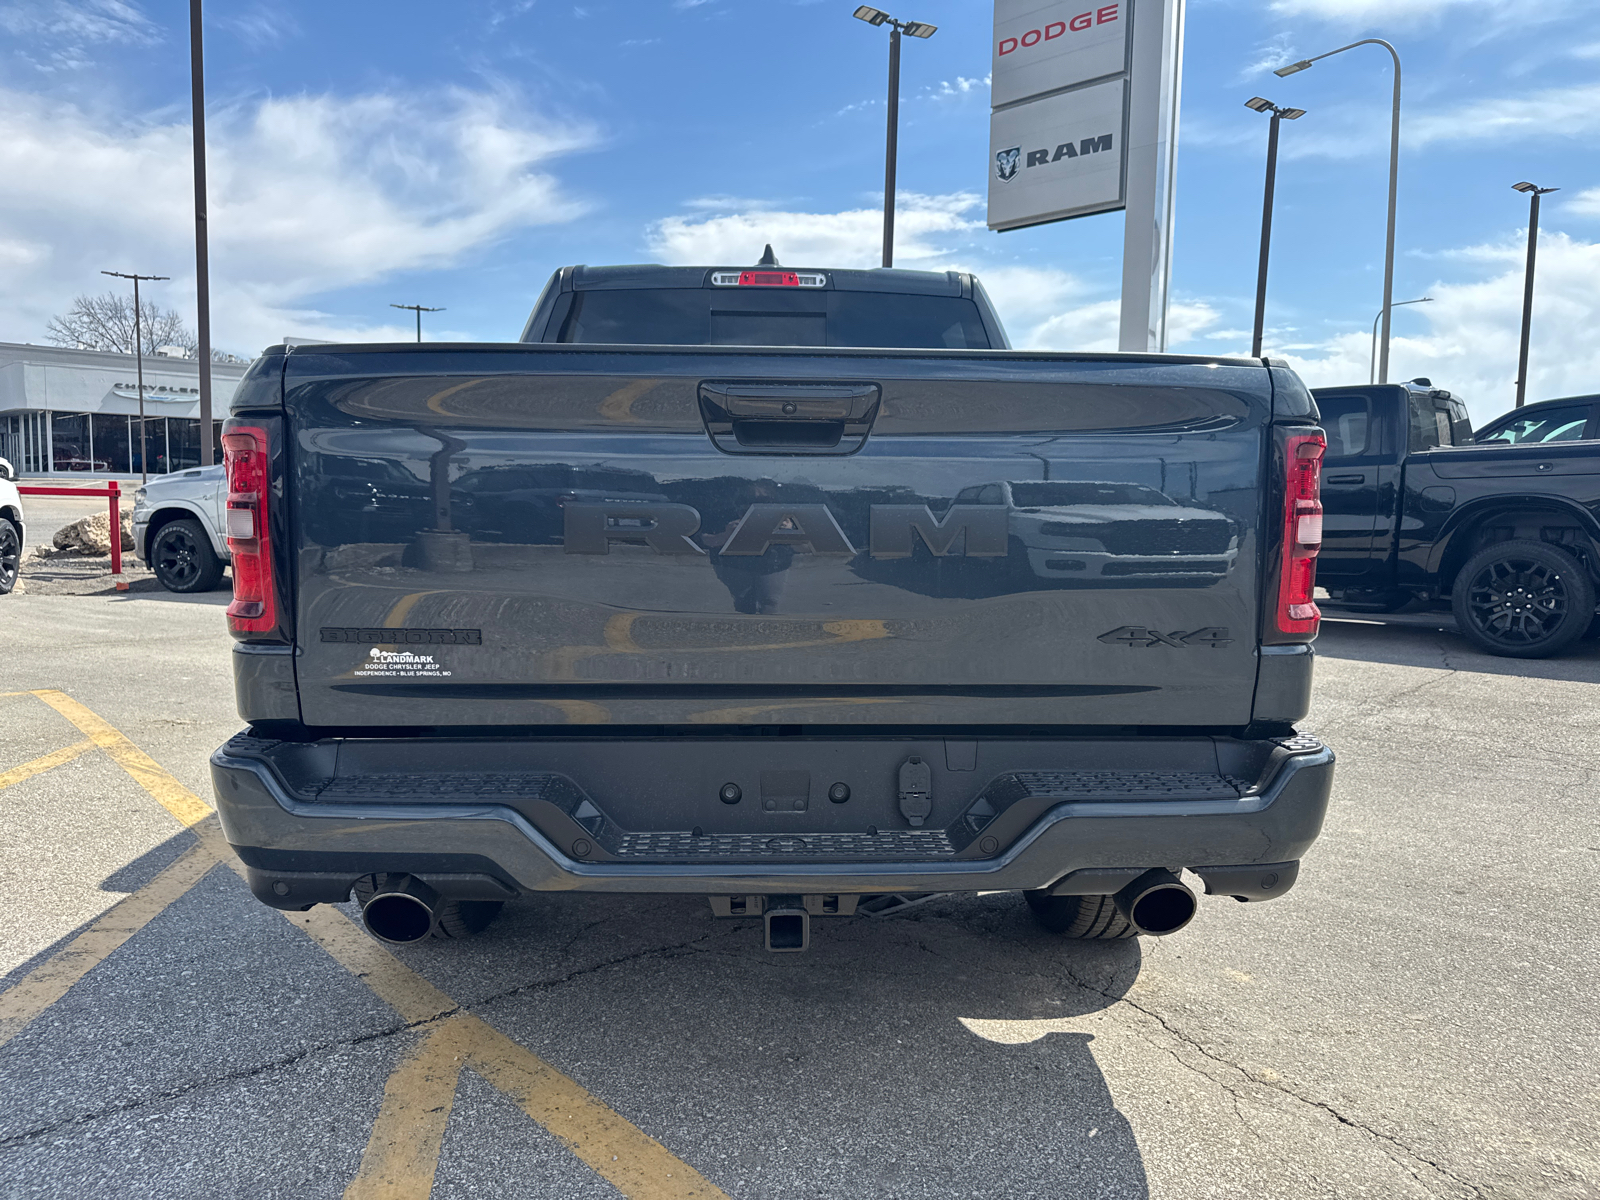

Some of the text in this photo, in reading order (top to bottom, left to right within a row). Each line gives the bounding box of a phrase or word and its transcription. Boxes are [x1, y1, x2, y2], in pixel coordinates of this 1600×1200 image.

[998, 4, 1119, 57] DODGE
[1026, 133, 1113, 168] RAM
[114, 383, 199, 394] CHRYSLER
[564, 502, 1009, 556] RAM
[380, 655, 434, 663] LANDMARK
